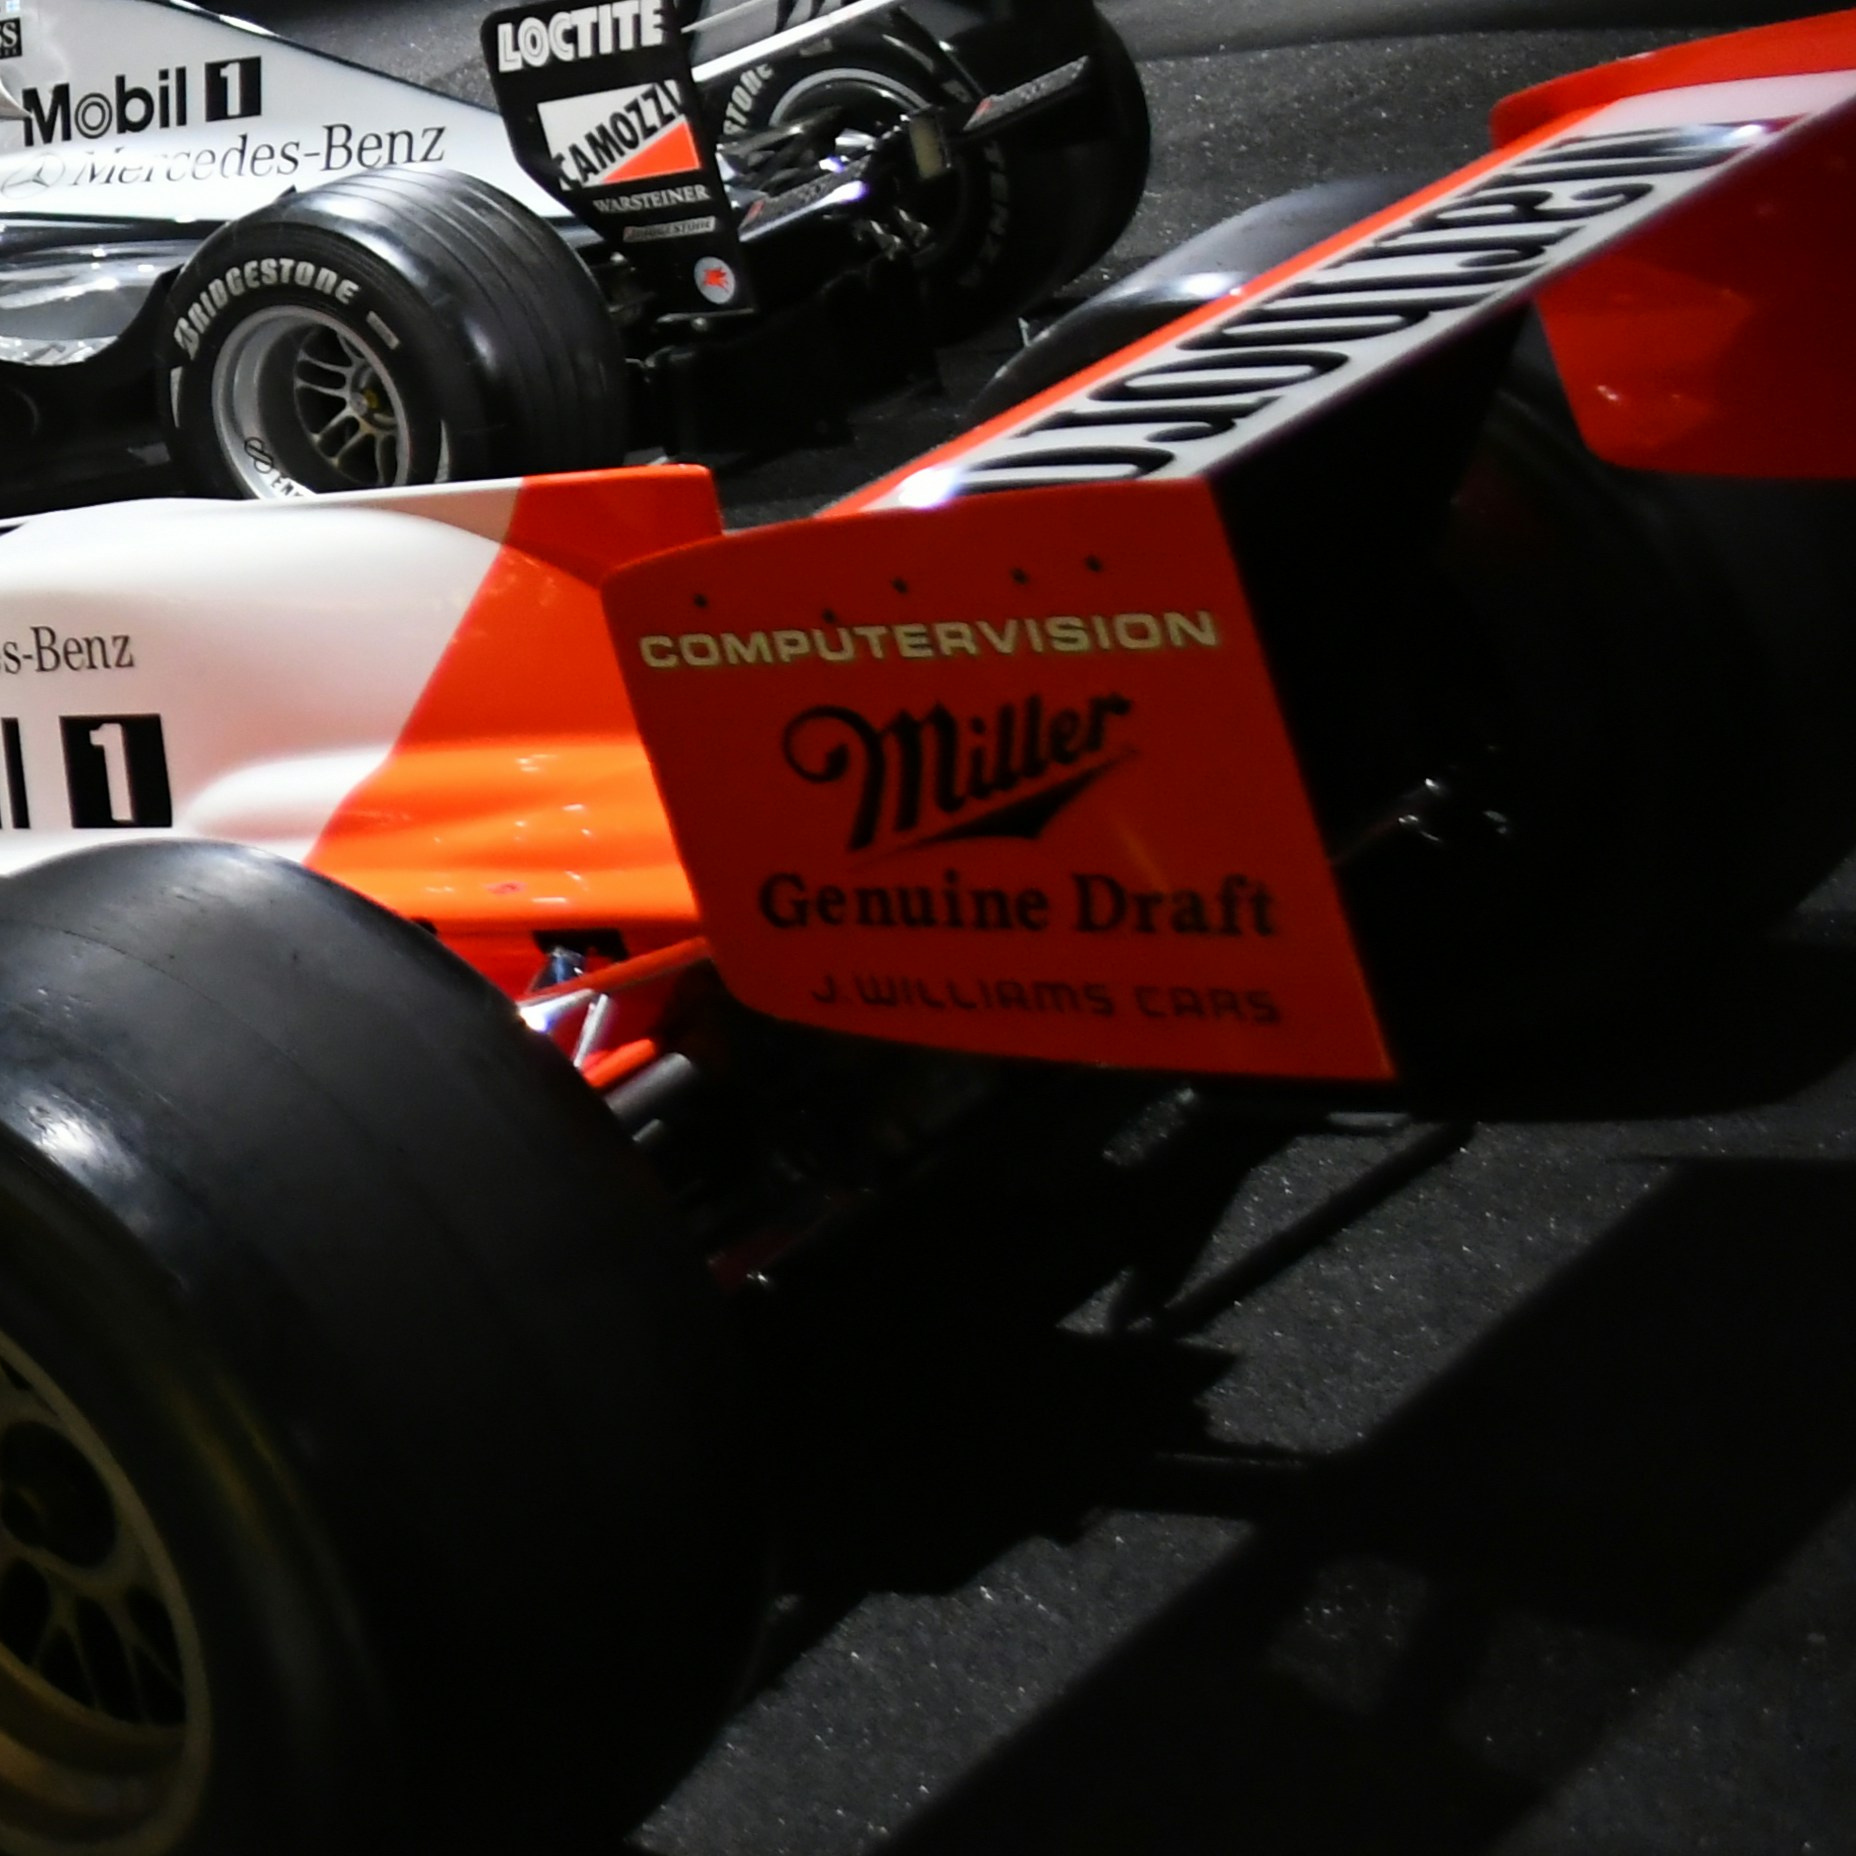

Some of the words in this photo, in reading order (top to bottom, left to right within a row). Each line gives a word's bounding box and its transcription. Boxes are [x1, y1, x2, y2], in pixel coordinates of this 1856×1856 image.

[22, 66, 186, 146] Mobil
[71, 121, 448, 187] Mercedes-Benz
[592, 184, 713, 213] WARSTEINER
[171, 256, 361, 361] BRIDGESTONE
[638, 609, 1222, 671] COMPUTERVISION
[780, 690, 1136, 852] Miller
[756, 868, 1051, 933] Genuine
[1071, 871, 1278, 937] Draft
[851, 973, 1117, 1018] WILLIAMS
[1132, 983, 1283, 1026] CARS
